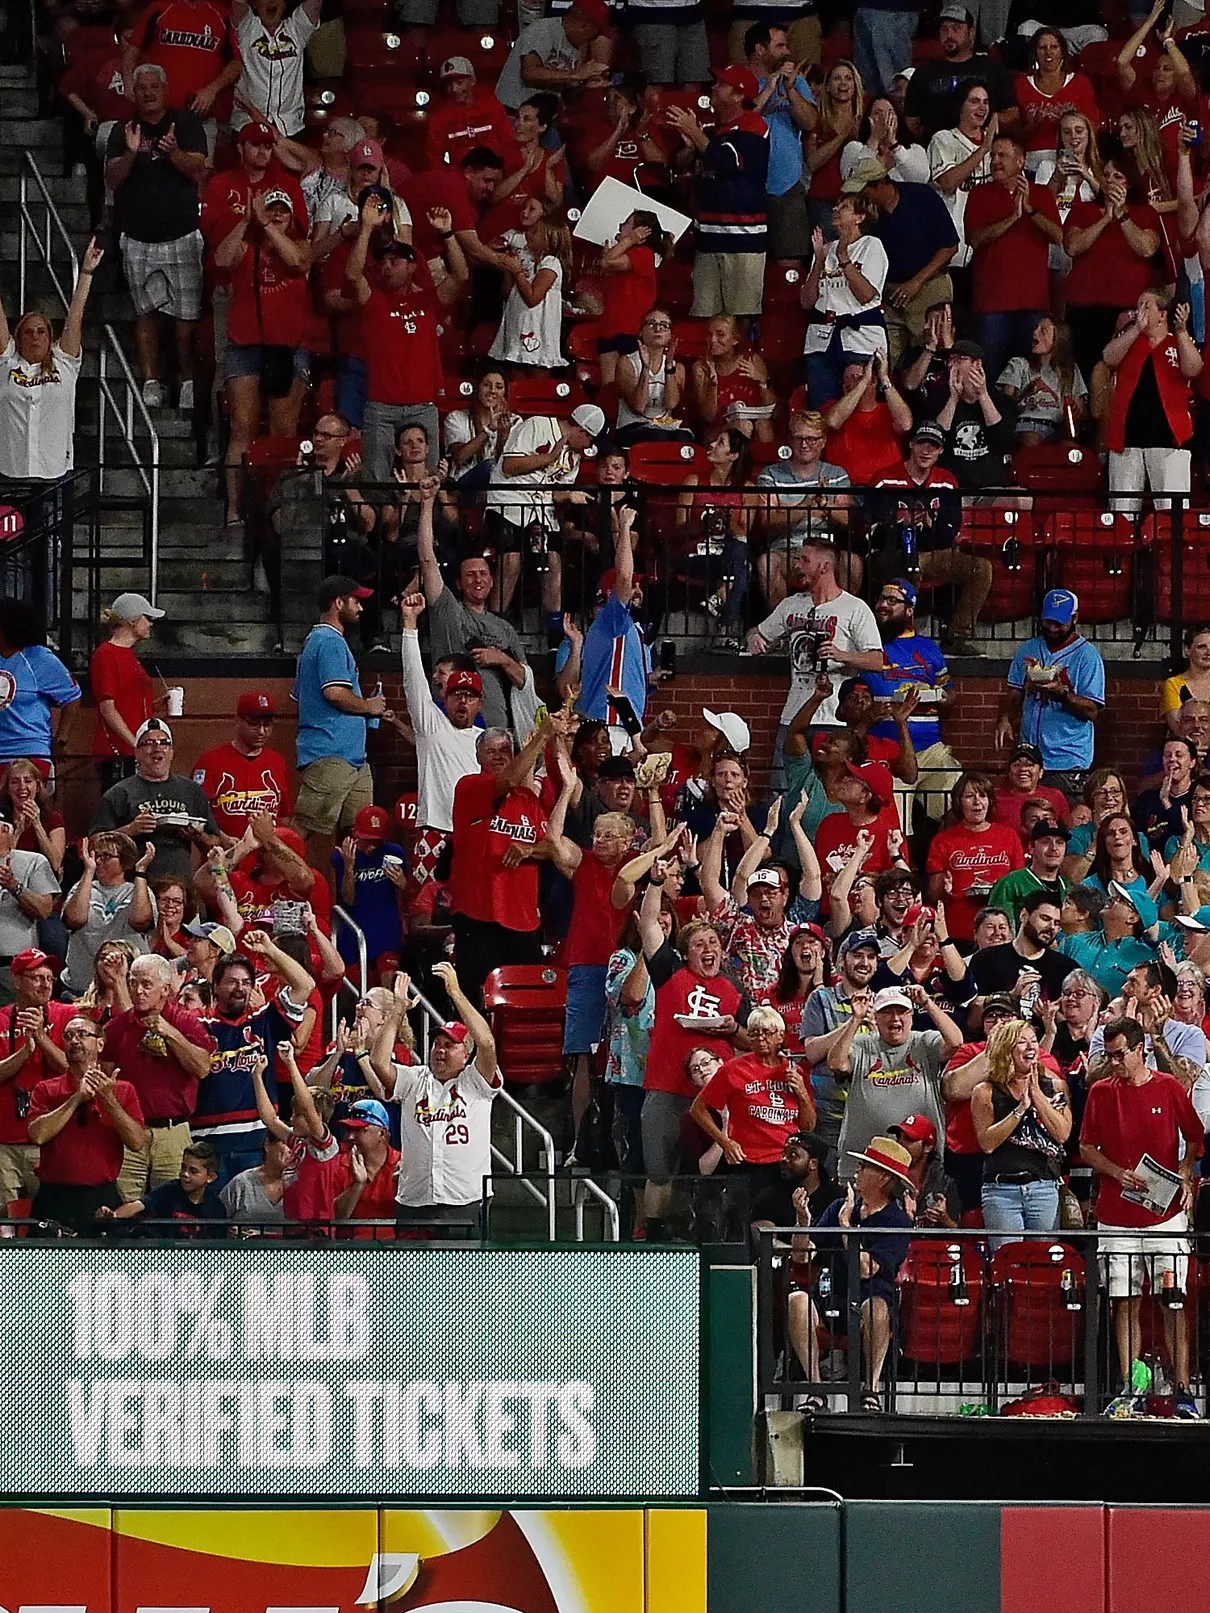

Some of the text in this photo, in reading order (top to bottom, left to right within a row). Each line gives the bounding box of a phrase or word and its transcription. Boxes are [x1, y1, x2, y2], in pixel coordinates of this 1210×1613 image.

[155, 799, 187, 812] LOUIS
[399, 803, 417, 820] 12
[872, 1072, 919, 1087] Cardinals
[445, 1124, 469, 1146] 29
[66, 1272, 372, 1361] 100% MLB
[66, 1379, 598, 1470] VERIFIED TICKETS
